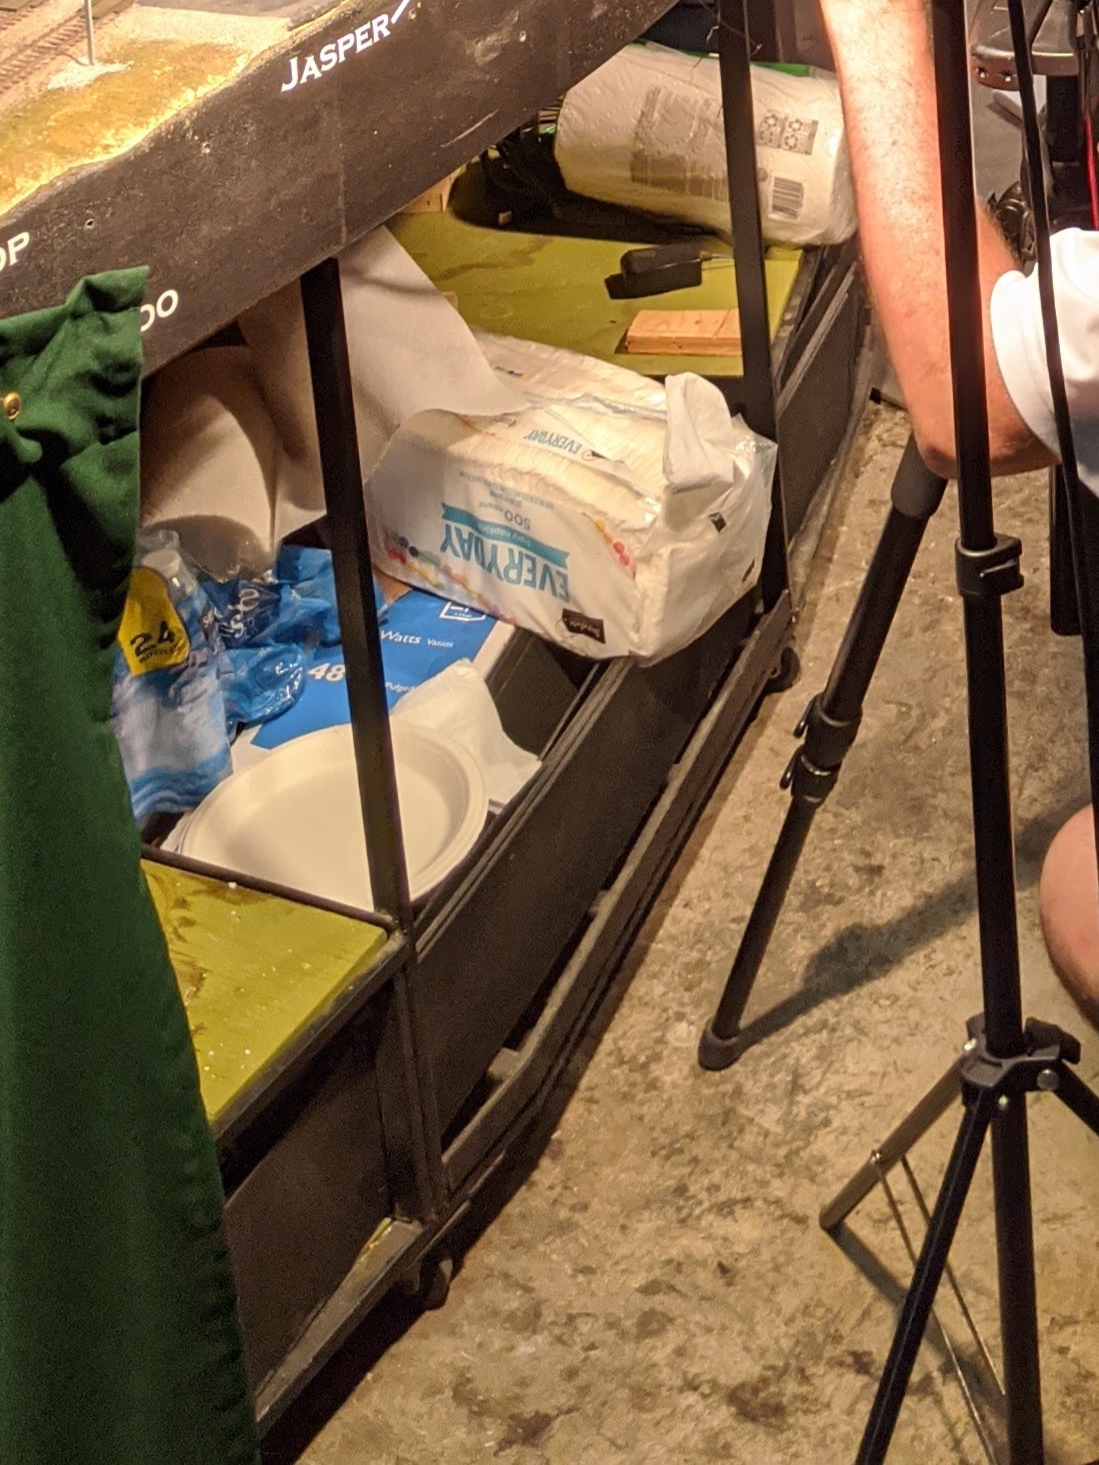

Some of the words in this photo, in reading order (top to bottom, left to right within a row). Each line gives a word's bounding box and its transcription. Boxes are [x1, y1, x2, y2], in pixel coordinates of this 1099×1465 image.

[281, 14, 391, 92] JASPER
[504, 510, 531, 531] 500
[440, 524, 570, 602] EVERYDAY
[130, 621, 175, 658] 24
[380, 629, 421, 644] Watts
[307, 663, 345, 682] 48
